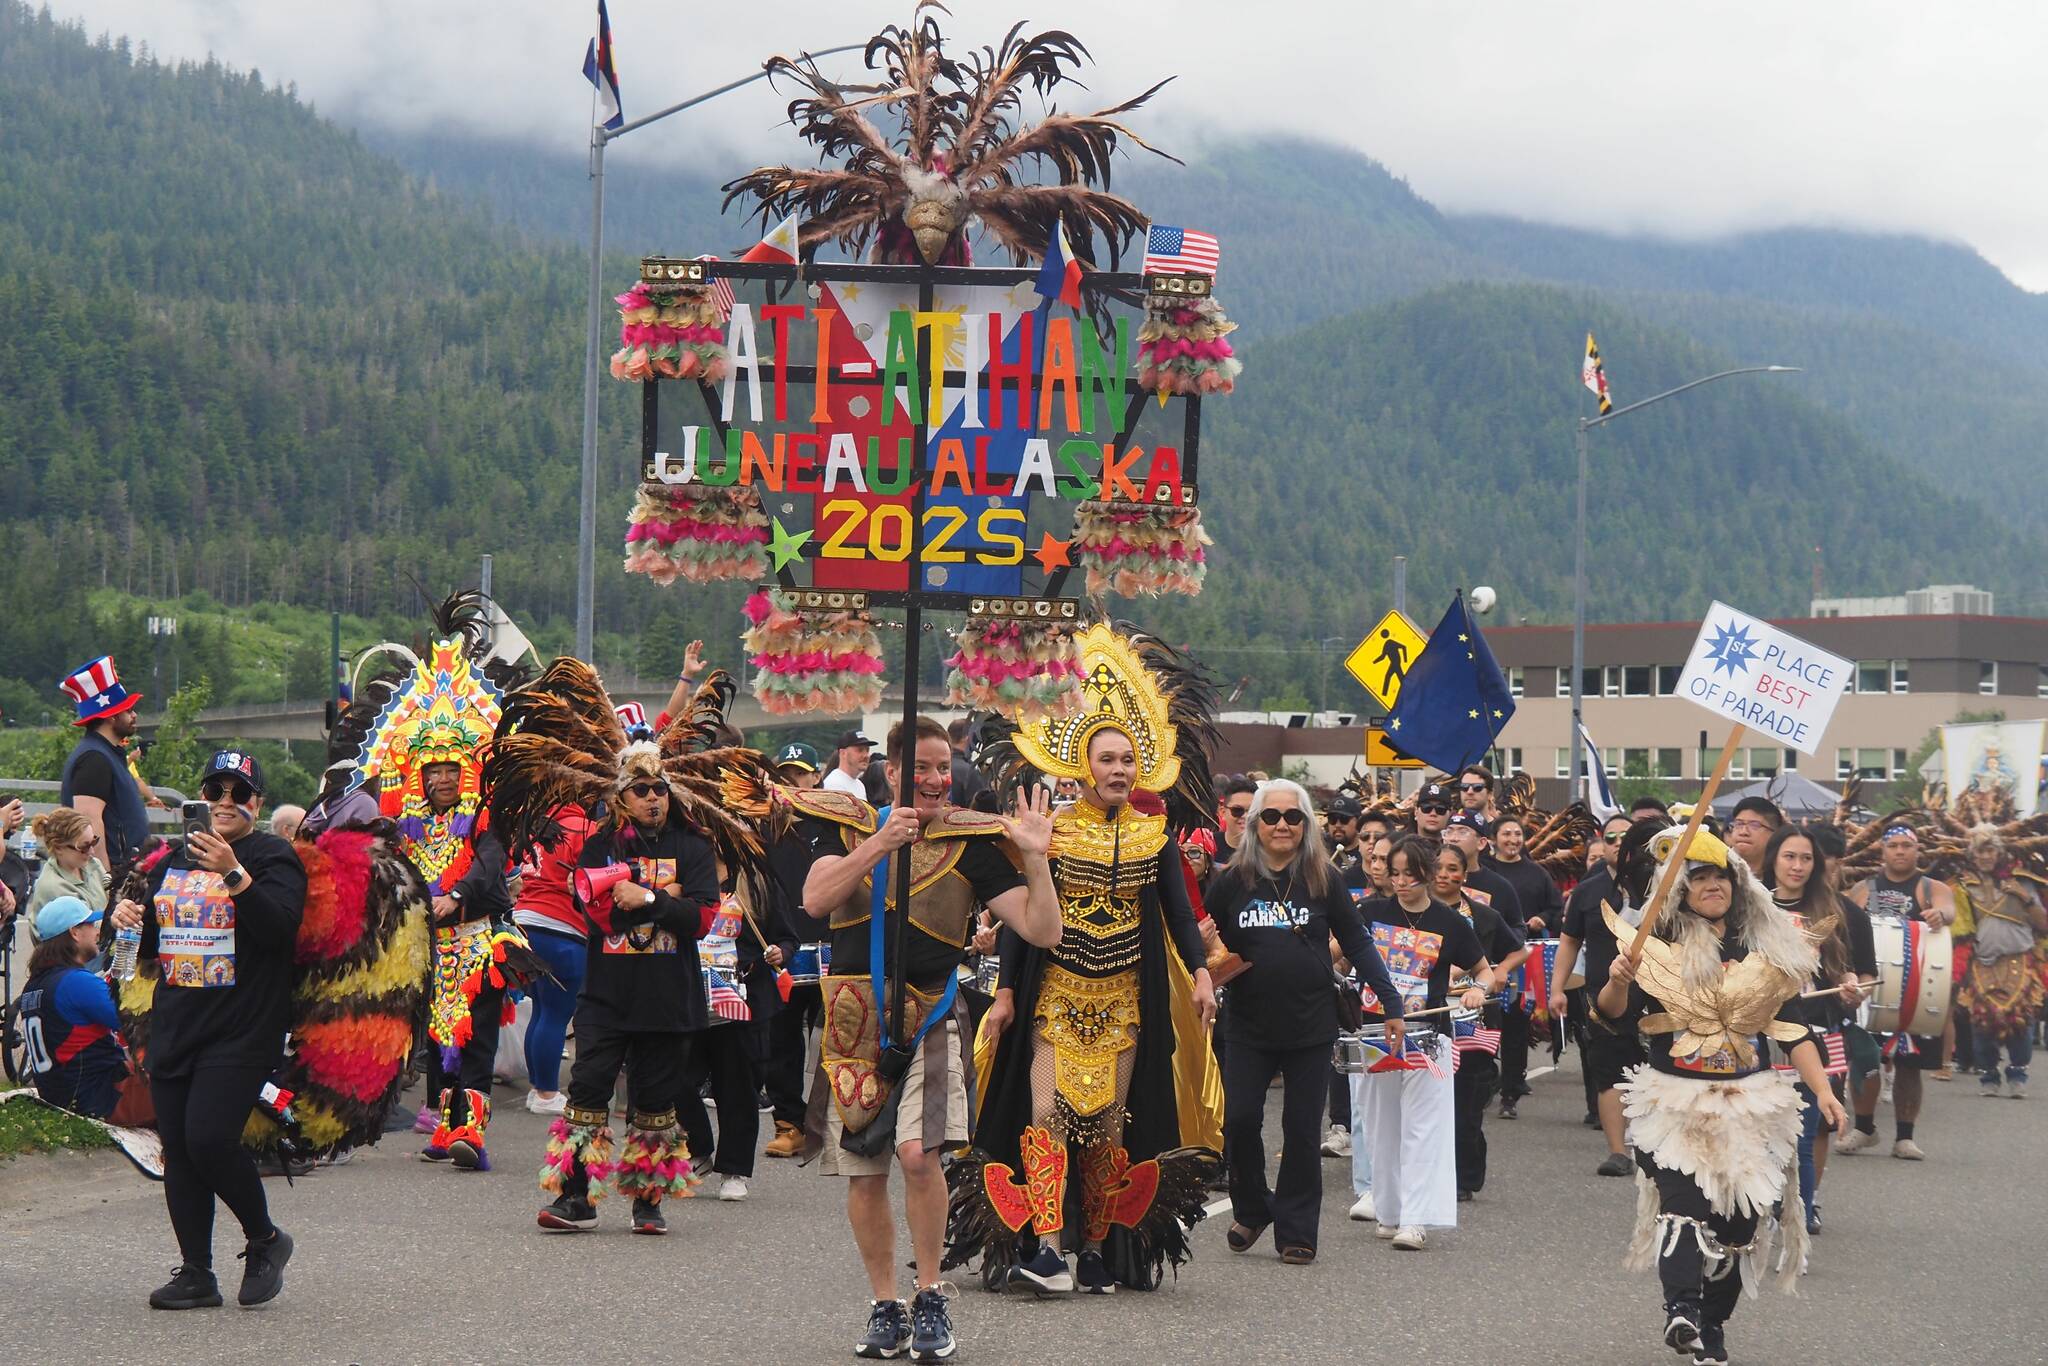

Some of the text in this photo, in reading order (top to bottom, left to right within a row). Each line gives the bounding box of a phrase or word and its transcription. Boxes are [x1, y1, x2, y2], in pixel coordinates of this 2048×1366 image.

[721, 303, 1128, 434] ATI-ATIHAN
[654, 425, 1184, 507] JUNEAU ALASKA
[821, 499, 1026, 566] 2025
[1719, 636, 1834, 689] 1st PLACE
[1756, 674, 1812, 710] BEST
[1690, 677, 1809, 743] OF PARADE
[215, 752, 252, 777] USA
[1257, 900, 1293, 911] TEAM
